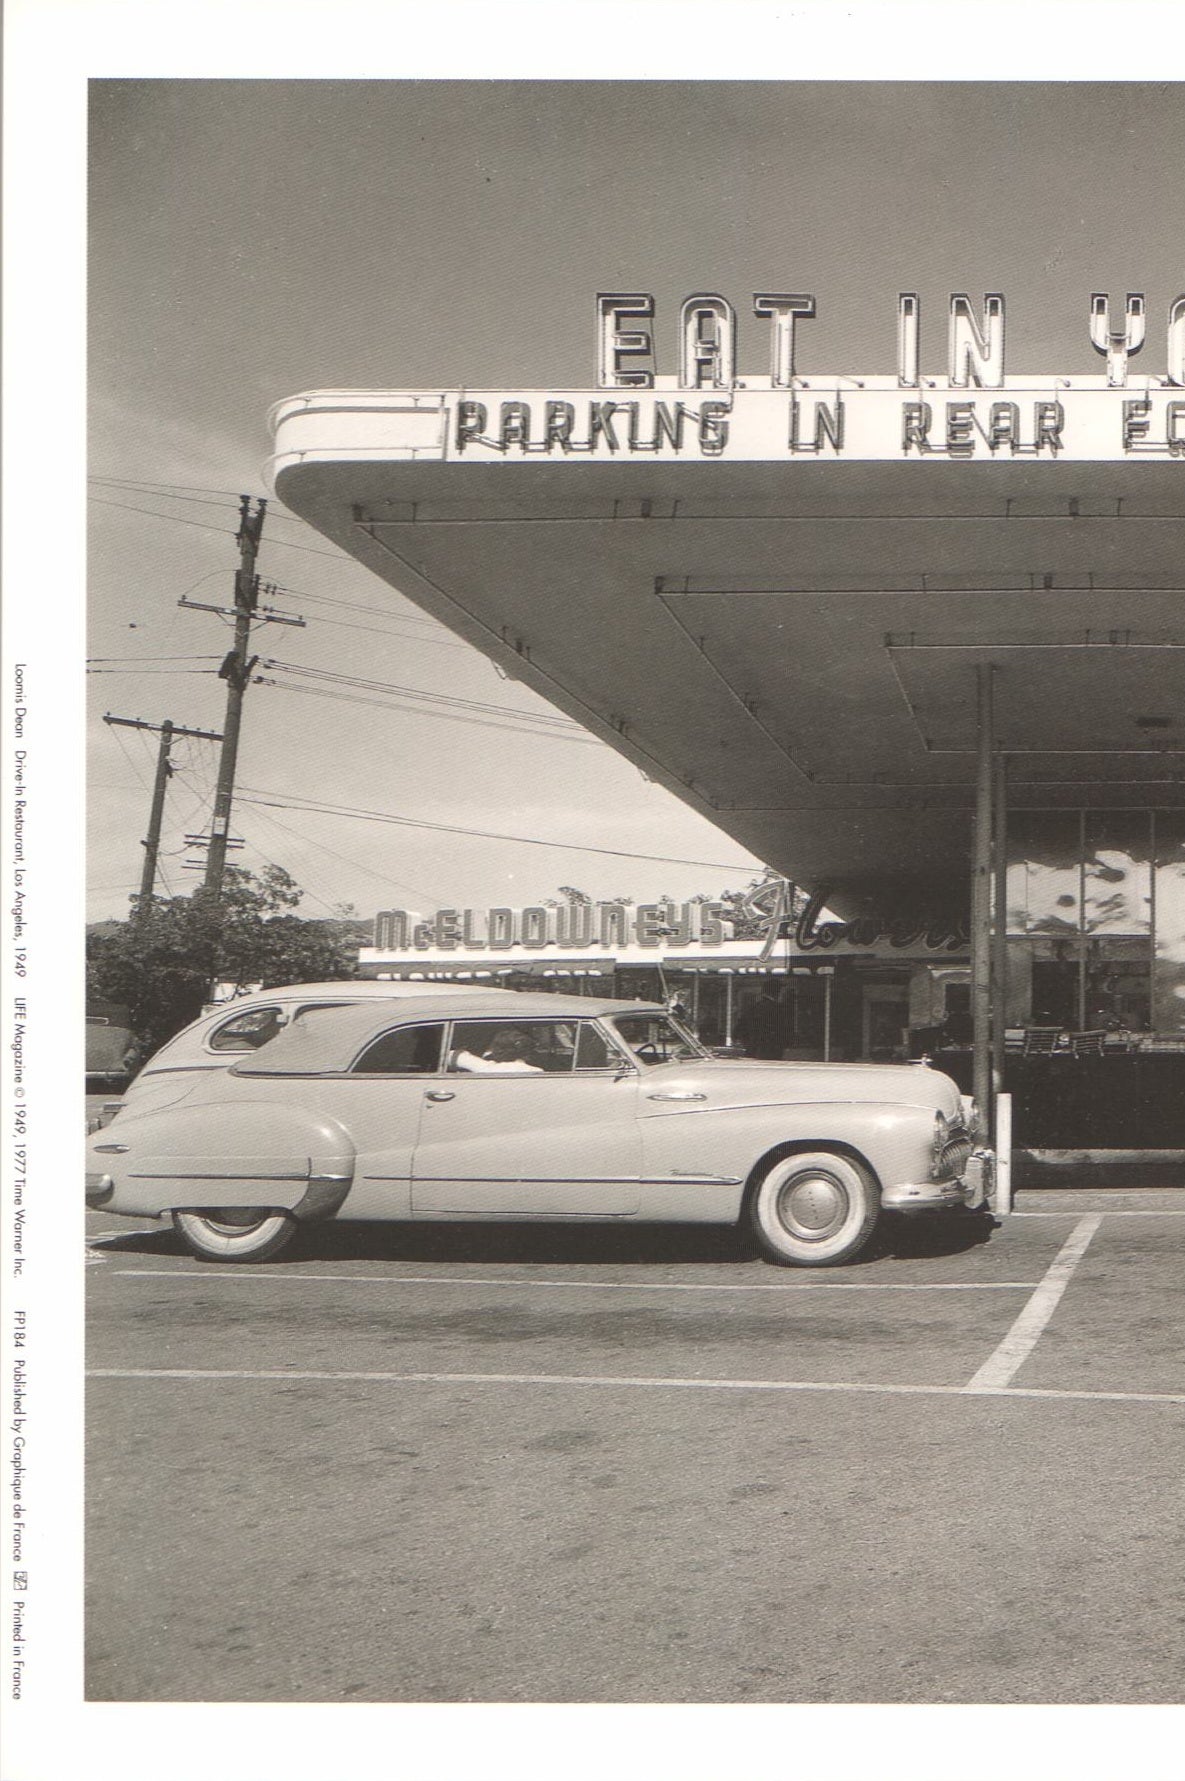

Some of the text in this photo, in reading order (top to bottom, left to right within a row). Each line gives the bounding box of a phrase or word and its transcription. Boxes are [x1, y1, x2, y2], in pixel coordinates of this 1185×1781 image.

[596, 292, 816, 390] EAT
[897, 291, 1006, 389] IN
[456, 398, 730, 456] PARKING
[790, 398, 844, 454] IN
[902, 400, 1066, 458] REAR
